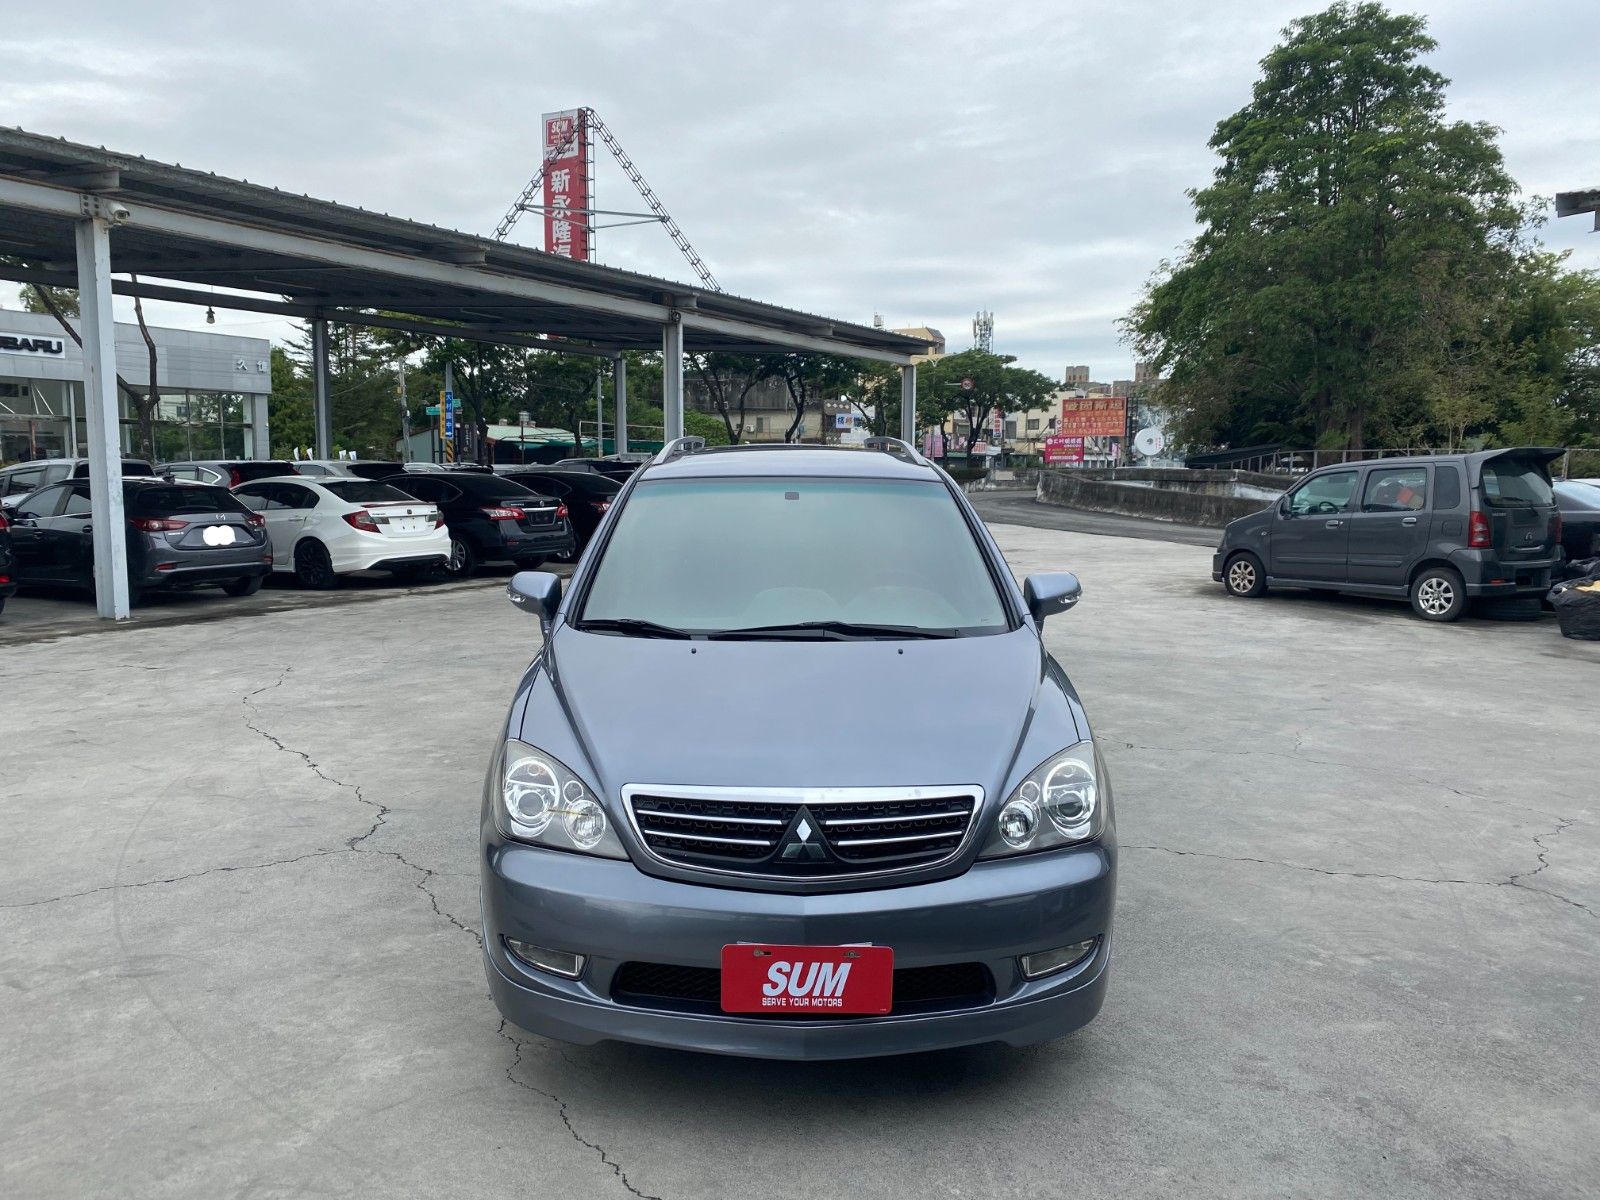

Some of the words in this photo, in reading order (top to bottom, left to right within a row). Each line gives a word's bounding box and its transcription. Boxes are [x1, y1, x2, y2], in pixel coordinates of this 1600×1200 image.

[0, 336, 63, 354] BARU
[762, 960, 852, 997] SUM
[761, 997, 787, 1006] SERVE
[789, 997, 810, 1007] YOUR
[811, 998, 843, 1007] MOTORS
